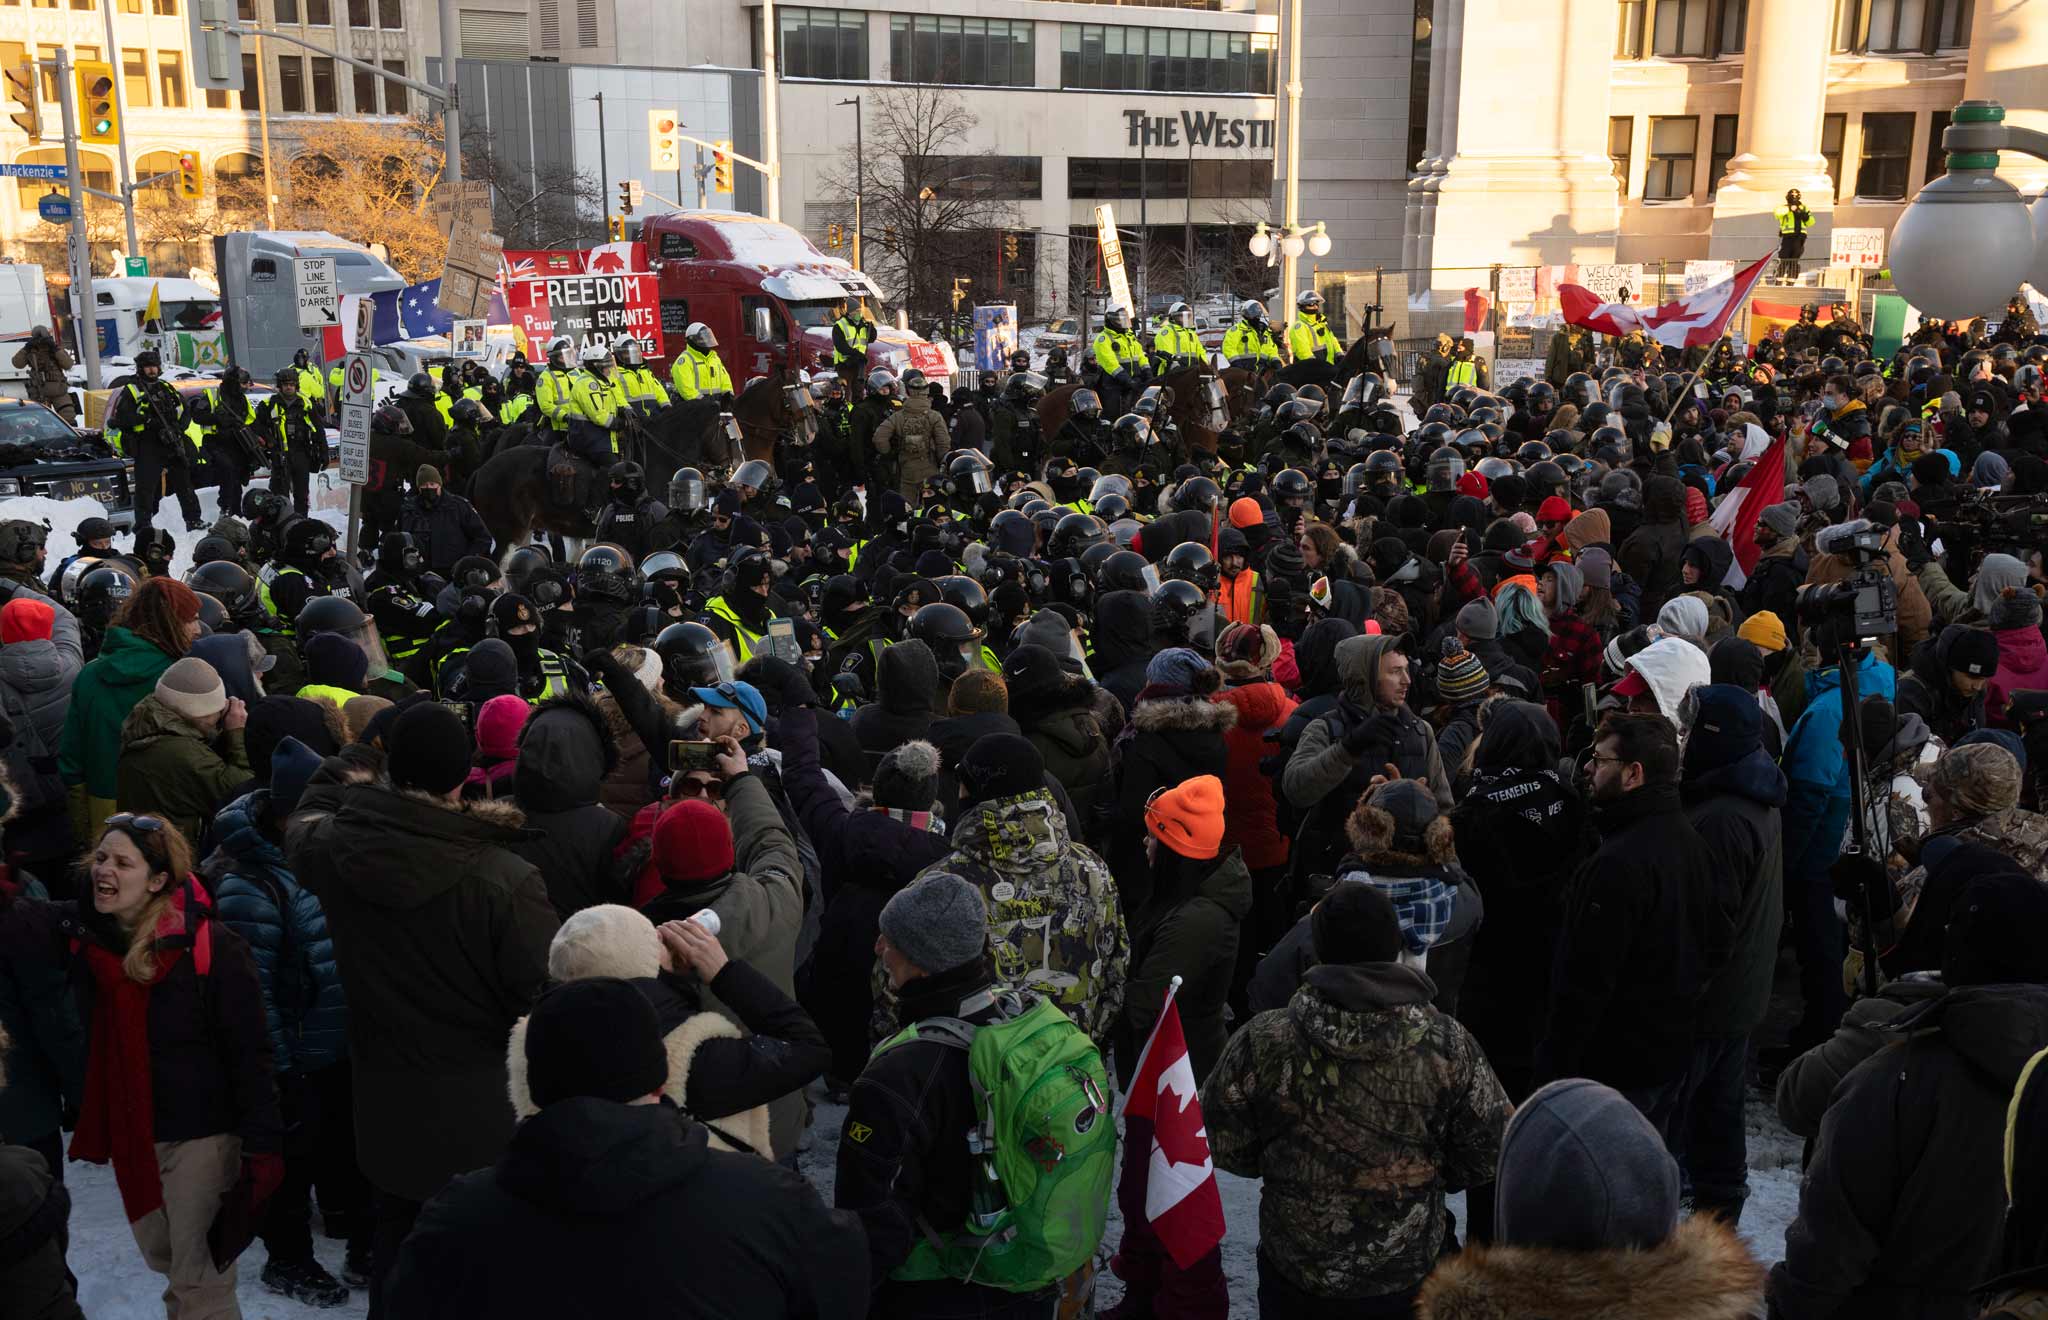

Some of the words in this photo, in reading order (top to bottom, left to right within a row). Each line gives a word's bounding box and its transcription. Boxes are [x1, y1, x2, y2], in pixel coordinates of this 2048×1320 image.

[1180, 110, 1275, 148] WESTI
[2, 165, 54, 178] Mackenzie
[303, 260, 326, 270] STOP
[1586, 265, 1633, 278] WELCOME
[306, 272, 326, 281] LINE
[304, 286, 329, 296] LIGNE
[1588, 278, 1633, 291] FREEDOM
[529, 276, 641, 308] FREEDOM
[300, 295, 335, 307] D'ARRÊT
[597, 307, 653, 328] ENFANTS
[70, 481, 85, 494] NO
[615, 514, 635, 522] POLICE
